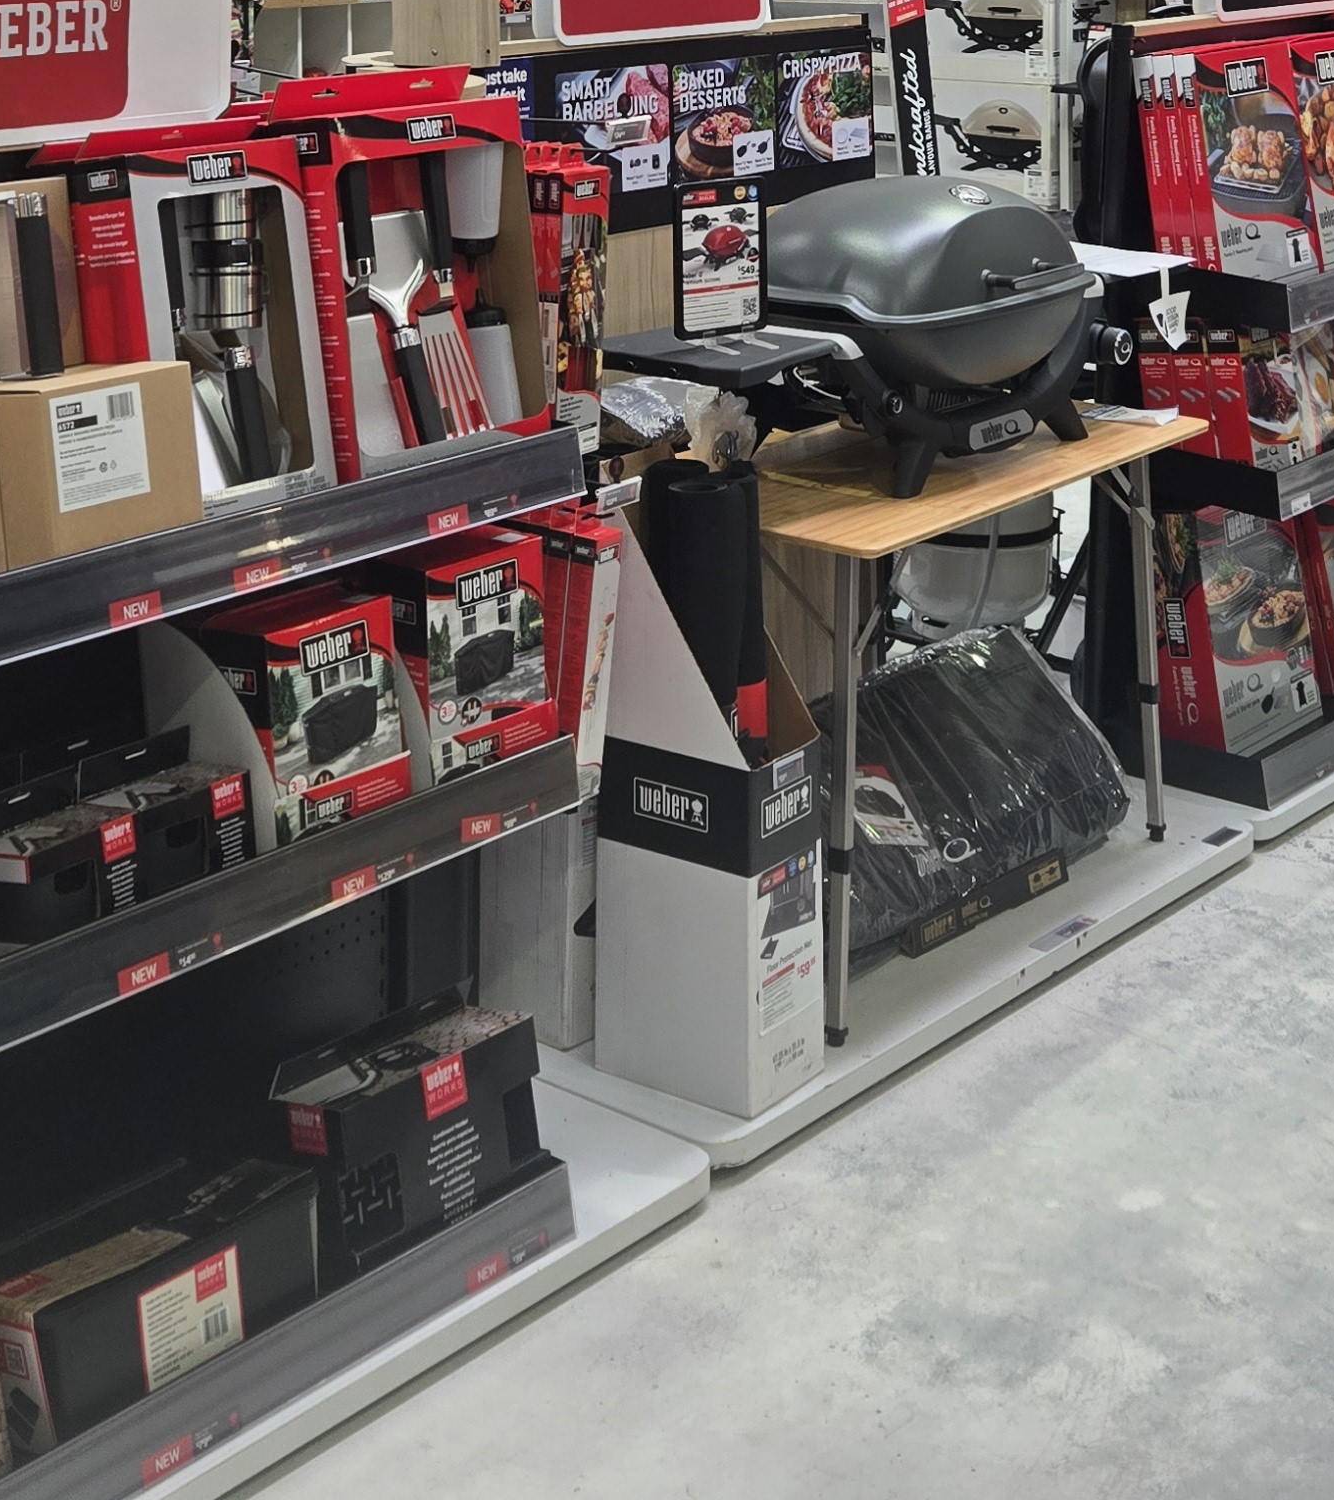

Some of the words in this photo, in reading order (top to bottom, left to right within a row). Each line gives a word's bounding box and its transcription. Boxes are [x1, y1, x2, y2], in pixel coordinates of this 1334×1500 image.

[502, 67, 528, 84] take
[782, 57, 825, 80] CRISPY
[827, 52, 863, 74] PIZZA
[1227, 62, 1258, 92] weber
[561, 77, 612, 101] SMART
[678, 67, 725, 92] BAKED
[679, 85, 746, 113] DESSERTS
[409, 117, 443, 141] weber
[191, 155, 232, 182] weber
[90, 173, 110, 189] weber
[576, 181, 595, 197] weber
[1221, 225, 1243, 248] weber
[246, 568, 271, 586] NEW
[461, 566, 503, 604] weber
[123, 601, 149, 618] NEW
[1167, 603, 1186, 648] weber
[304, 629, 353, 672] weber
[467, 737, 496, 758] weber
[213, 783, 233, 802] weber
[638, 783, 690, 822] weber
[215, 797, 244, 814] WORKS
[317, 795, 345, 817] weber
[765, 786, 801, 831] weber
[104, 823, 125, 843] weber
[471, 818, 492, 836] NEW
[106, 836, 136, 854] WORKS
[343, 875, 365, 895] NEW
[766, 959, 779, 975] Floor
[779, 945, 802, 967] Protection
[131, 962, 158, 985] NEW
[425, 1065, 452, 1091] weber
[427, 1079, 464, 1105] WORKS
[477, 1260, 498, 1283] NEW
[154, 1446, 181, 1473] NEW
